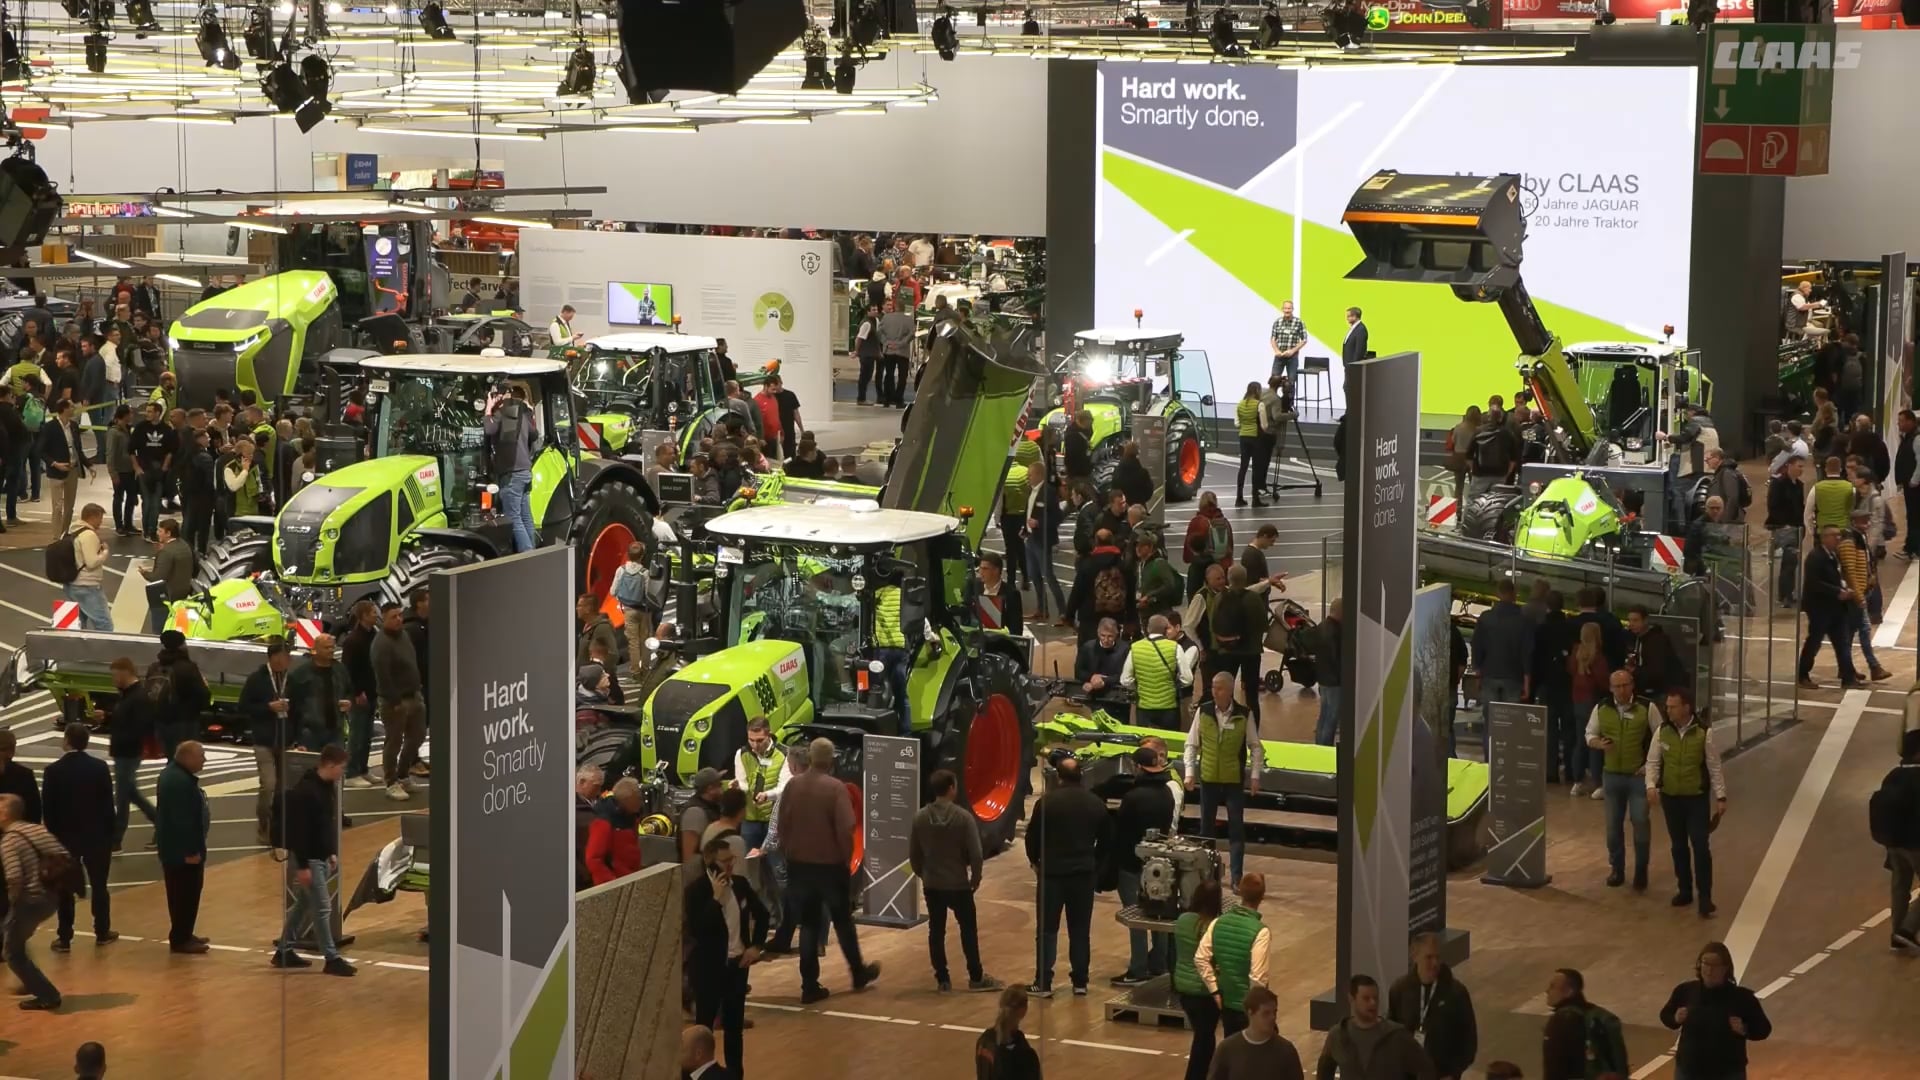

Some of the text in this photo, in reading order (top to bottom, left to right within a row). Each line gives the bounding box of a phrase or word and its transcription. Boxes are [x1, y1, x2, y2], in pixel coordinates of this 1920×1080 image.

[1395, 10, 1433, 25] JOHN
[1121, 77, 1247, 100] Hard work.
[1120, 102, 1265, 130] Smartly done.
[1524, 173, 1640, 197] by CLAAS
[1543, 199, 1579, 211] Jahre
[1582, 199, 1639, 212] JAGUAR
[1535, 215, 1639, 229] 20 Jahre Traktor
[1375, 434, 1398, 458] Hard
[1375, 457, 1400, 481] work.
[1374, 479, 1405, 505] Smartly
[1373, 507, 1397, 528] done.
[779, 658, 798, 674] CLAAS
[483, 672, 529, 712] Hard
[483, 707, 534, 745] work.
[483, 737, 547, 781] Smartly
[482, 781, 531, 815] done.
